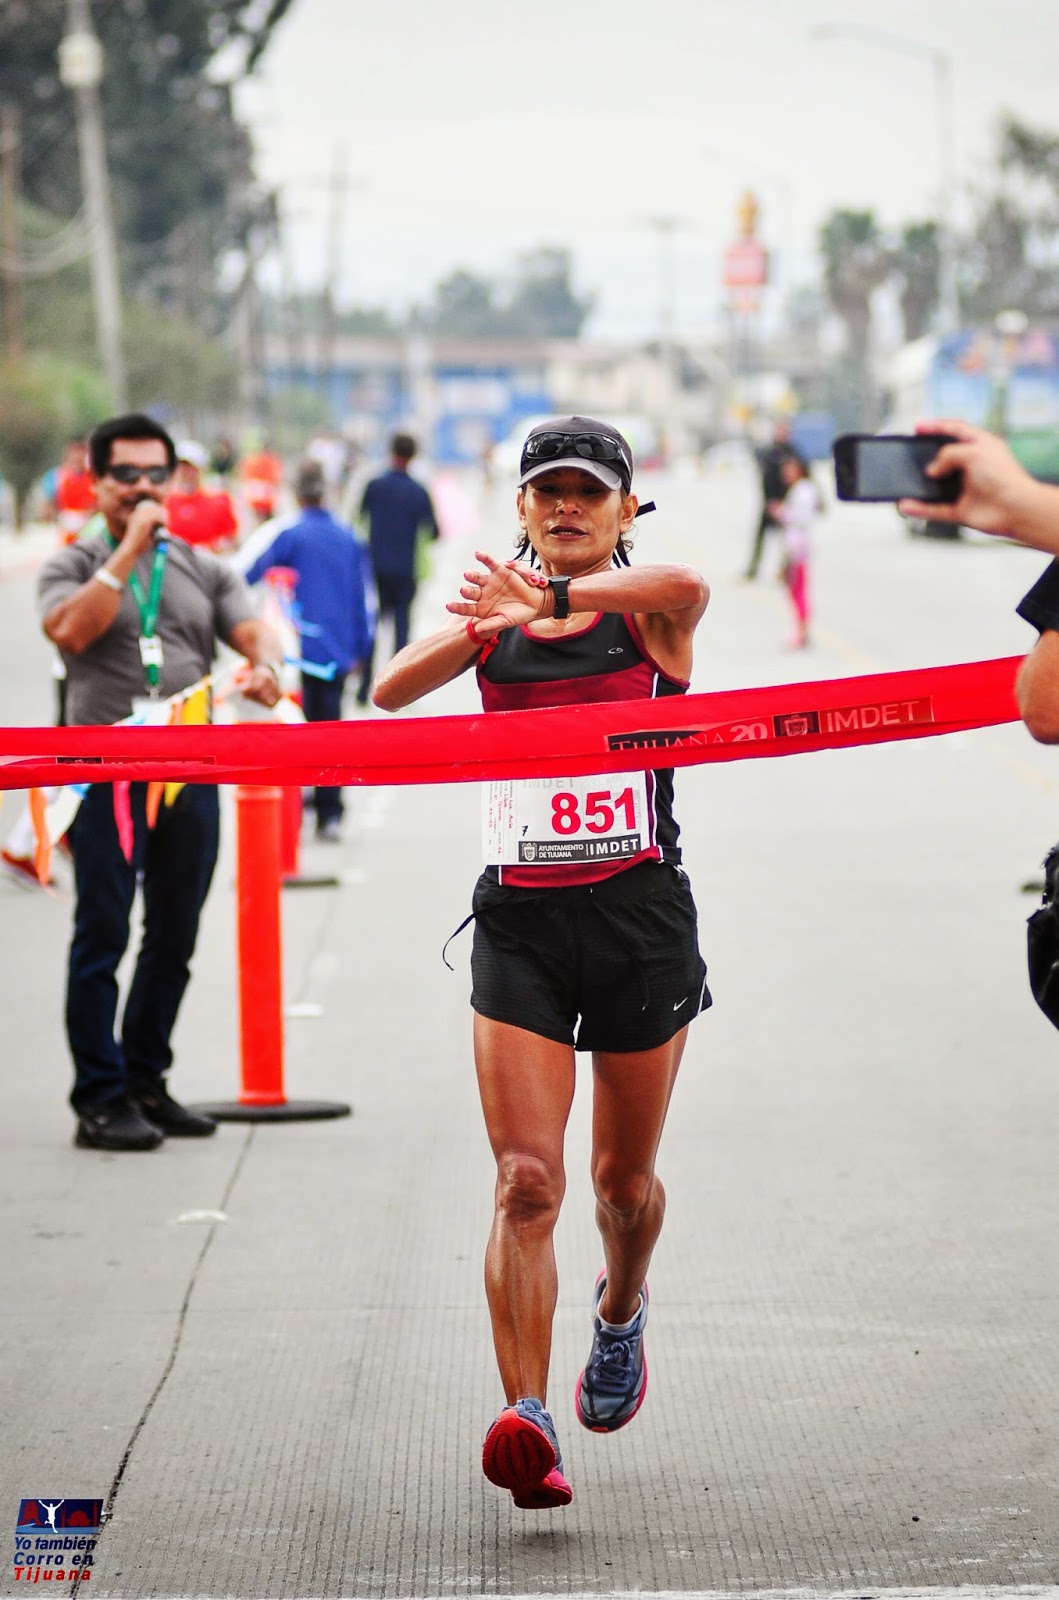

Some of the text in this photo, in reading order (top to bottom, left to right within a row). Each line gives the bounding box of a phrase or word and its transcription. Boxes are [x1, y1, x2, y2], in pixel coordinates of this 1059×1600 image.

[827, 700, 920, 733] IMDET
[551, 787, 636, 836] 851
[538, 843, 584, 852] AYUNTAMIENTO
[538, 851, 546, 859] DE
[589, 838, 639, 856] IMDET
